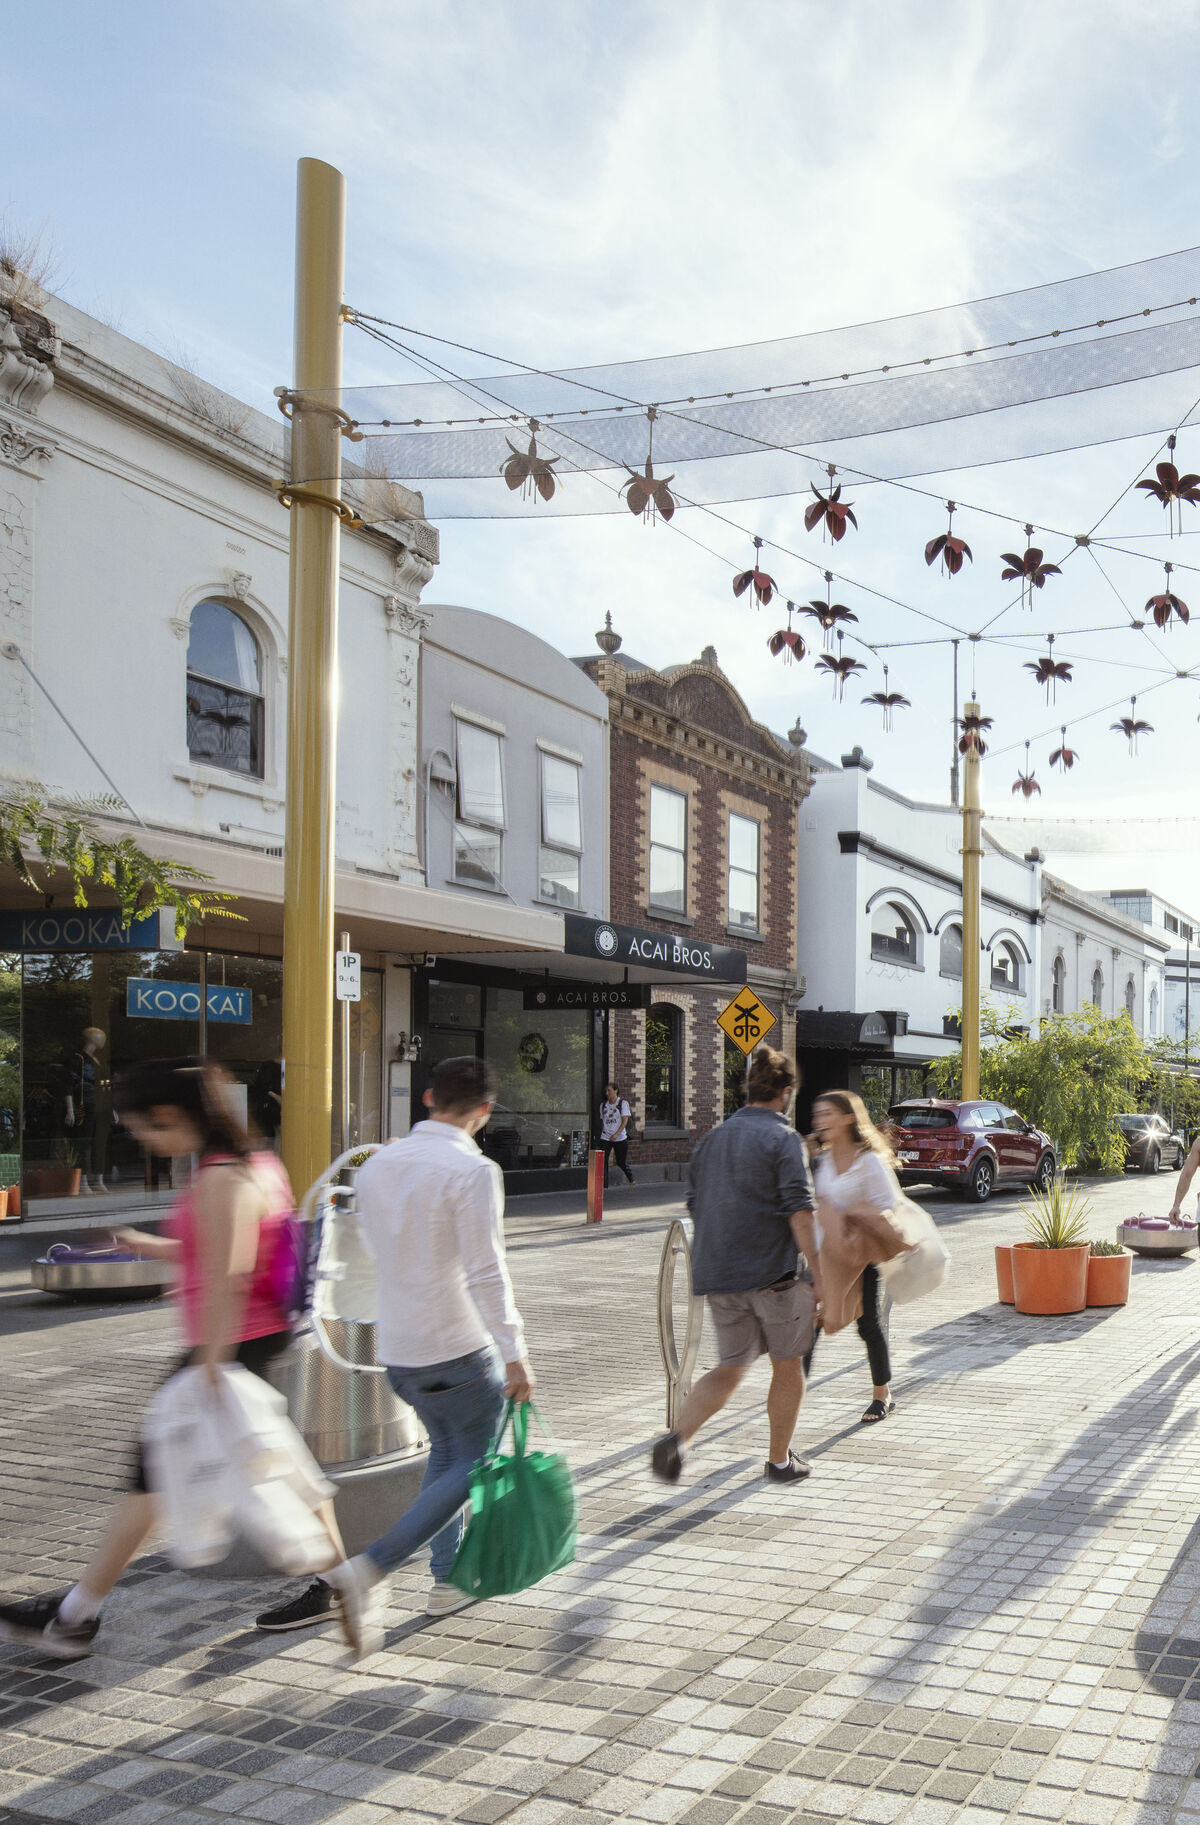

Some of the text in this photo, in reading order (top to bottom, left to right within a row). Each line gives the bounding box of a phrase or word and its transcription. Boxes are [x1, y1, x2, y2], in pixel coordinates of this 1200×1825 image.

[628, 936, 668, 961] ACAI
[673, 945, 715, 970] BROS.
[342, 956, 356, 968] 1P
[557, 991, 631, 1003] ACAI BROS.
